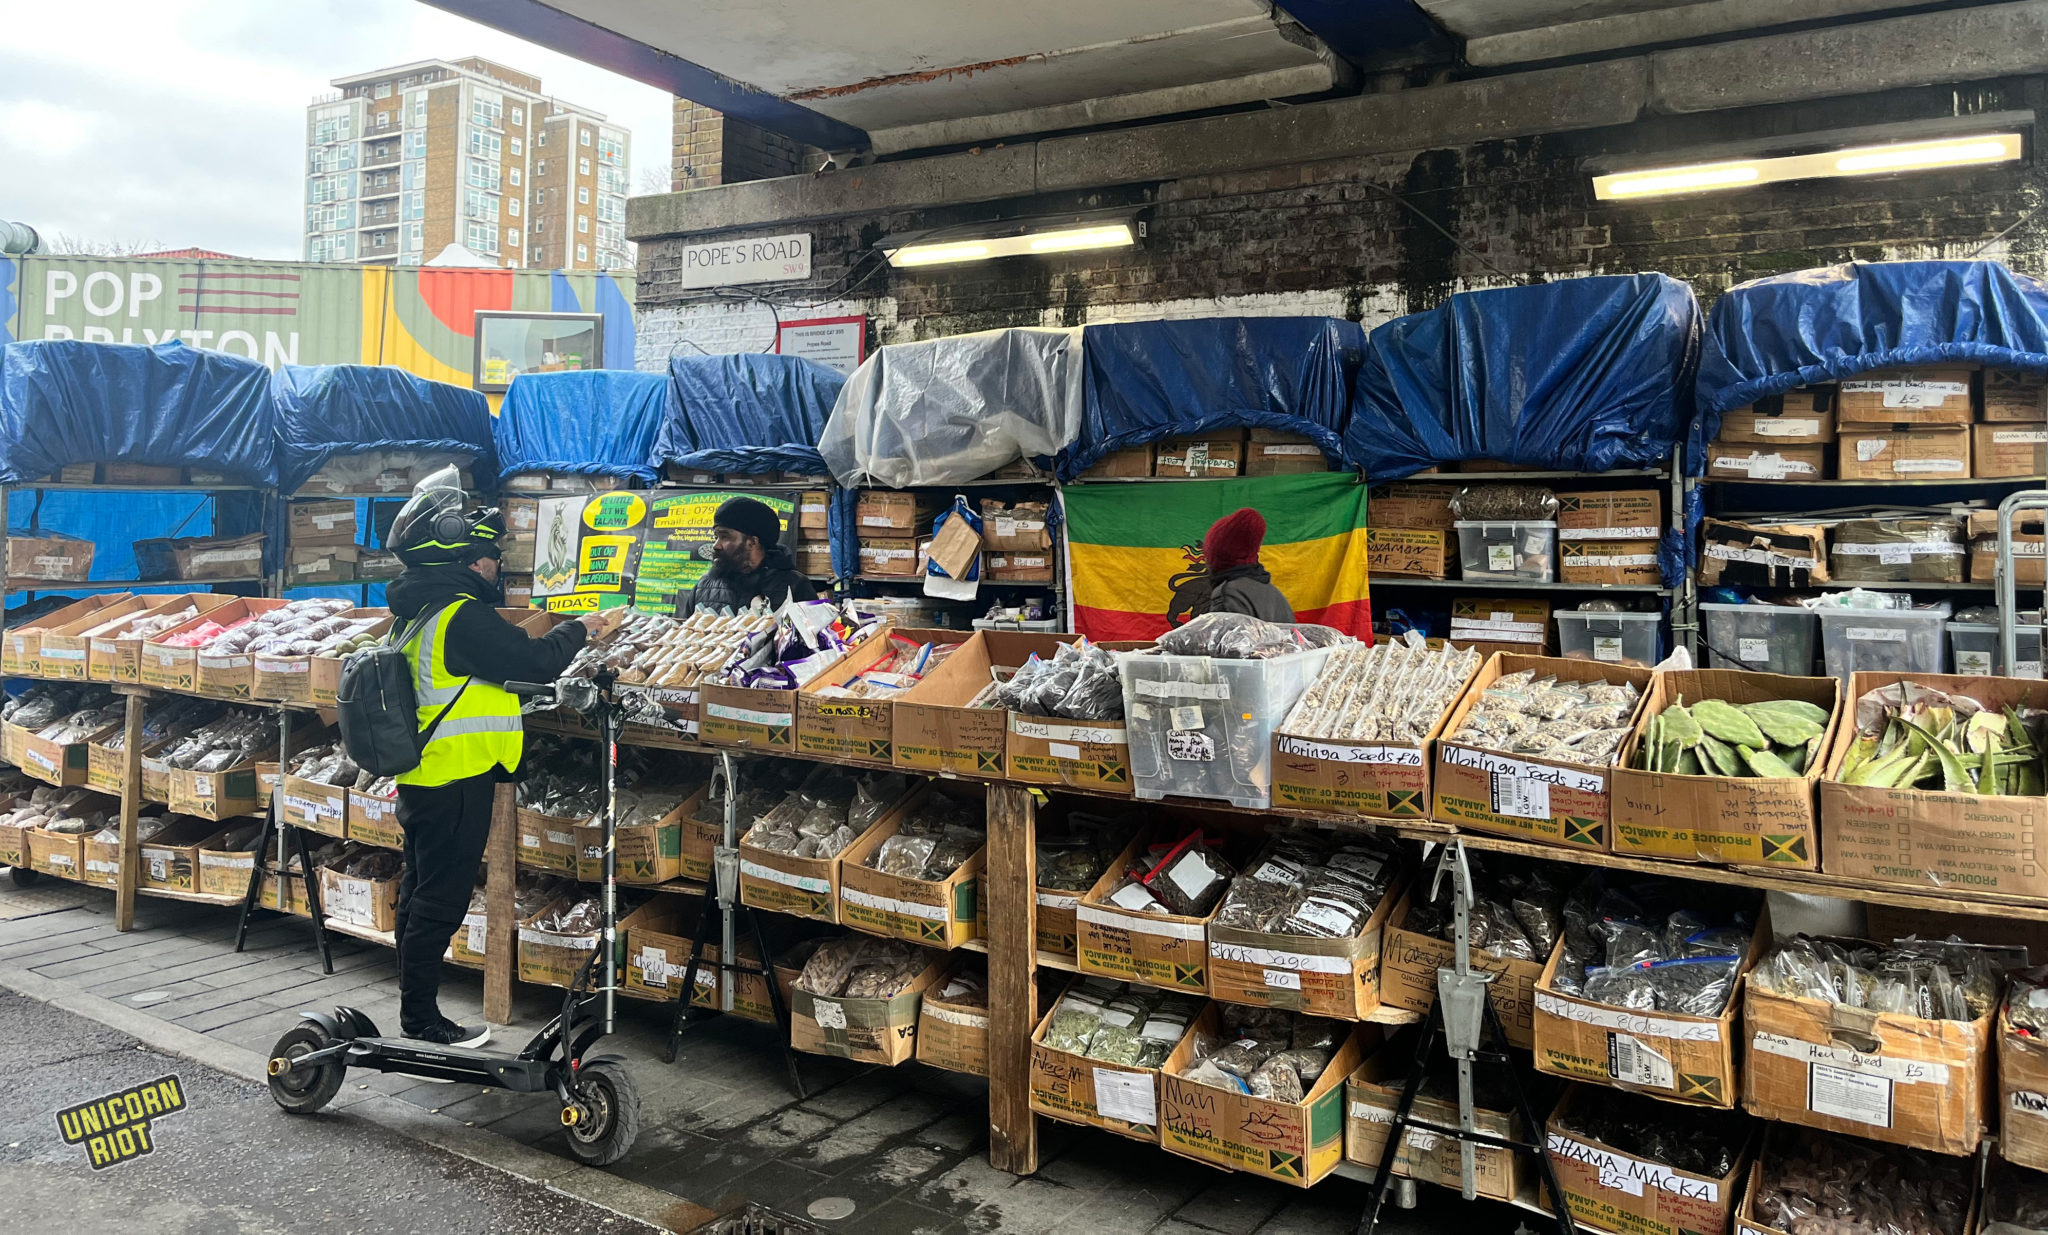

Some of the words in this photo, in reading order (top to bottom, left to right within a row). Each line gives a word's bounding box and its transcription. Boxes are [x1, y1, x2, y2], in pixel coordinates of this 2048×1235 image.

[688, 245, 746, 268] POPE'S
[46, 270, 162, 318] POP
[652, 497, 686, 509] DIDA'S
[689, 494, 736, 504] JAMAICA
[694, 506, 716, 515] 079
[547, 597, 598, 611] DIDA'S
[839, 738, 868, 748] PRODUCE
[898, 745, 927, 755] JAMAICA
[928, 748, 938, 757] OF
[939, 750, 973, 760] PRODUCE
[1277, 735, 1339, 761] Moringa
[1349, 744, 1394, 762] Seeds
[1396, 752, 1421, 765] £10
[1013, 755, 1040, 766] JAMAICA
[1041, 758, 1054, 767] OF
[1057, 761, 1096, 771] PRODUCE
[1442, 745, 1516, 777] Moringa
[1525, 765, 1566, 787] Seeds
[1278, 784, 1316, 797] JAMAICA
[1319, 789, 1332, 799] OF
[1334, 790, 1381, 801] PRODUCE
[1441, 796, 1486, 811] JAMAICA
[1919, 795, 1957, 804] WEIGHT
[1958, 797, 1979, 805] NET
[1464, 811, 1493, 824] PACKED
[1495, 817, 1517, 827] WHEN
[1964, 813, 2015, 824] TURMERIC
[1518, 821, 1534, 830] NET
[1846, 819, 1891, 830] DASHEEN
[1618, 825, 1669, 839] JAMAICA
[1673, 832, 1688, 841] OF
[1958, 830, 1977, 838] YAM
[1978, 831, 2016, 841] NEGRO
[1692, 833, 1752, 846] PRODUCE
[1837, 834, 1857, 842] YAM
[1858, 836, 1891, 846] SWEET
[1916, 842, 1934, 850] YAM
[1935, 844, 1972, 854] YELLOW
[1973, 846, 2016, 857] REGULAR
[1840, 850, 1860, 859] YAM
[1861, 852, 1892, 861] LUCEA
[1937, 859, 1957, 868] YAM
[1957, 861, 1999, 872] YELLOW
[1873, 865, 1922, 878] JAMAICA
[1943, 871, 1998, 886] PRODUCE
[845, 904, 874, 918] JAMAICA
[875, 911, 884, 920] OF
[886, 912, 918, 927] PRODUCE
[1084, 950, 1118, 963] JAMAICA
[1119, 957, 1130, 965] OF
[1133, 959, 1171, 971] PRODUCE
[1546, 1048, 1595, 1067] JAMAICA
[1905, 1064, 1924, 1078] £5
[1034, 1089, 1068, 1104] JAMAICA
[1165, 1080, 1216, 1115] Man
[1070, 1099, 1081, 1107] OF
[1188, 1140, 1211, 1153] PACKED
[1222, 1140, 1264, 1157] PRODUCE
[1231, 1151, 1244, 1161] NET
[1546, 1133, 1620, 1173] SHAMA
[1627, 1160, 1711, 1202] MACKA
[1600, 1171, 1629, 1191] £5
[1564, 1191, 1597, 1210] JAMAI
[1574, 1205, 1604, 1223] PACKED
[1600, 1203, 1614, 1214] OF
[1606, 1215, 1628, 1229] WHEN
[1617, 1207, 1671, 1235] PRODUCE
